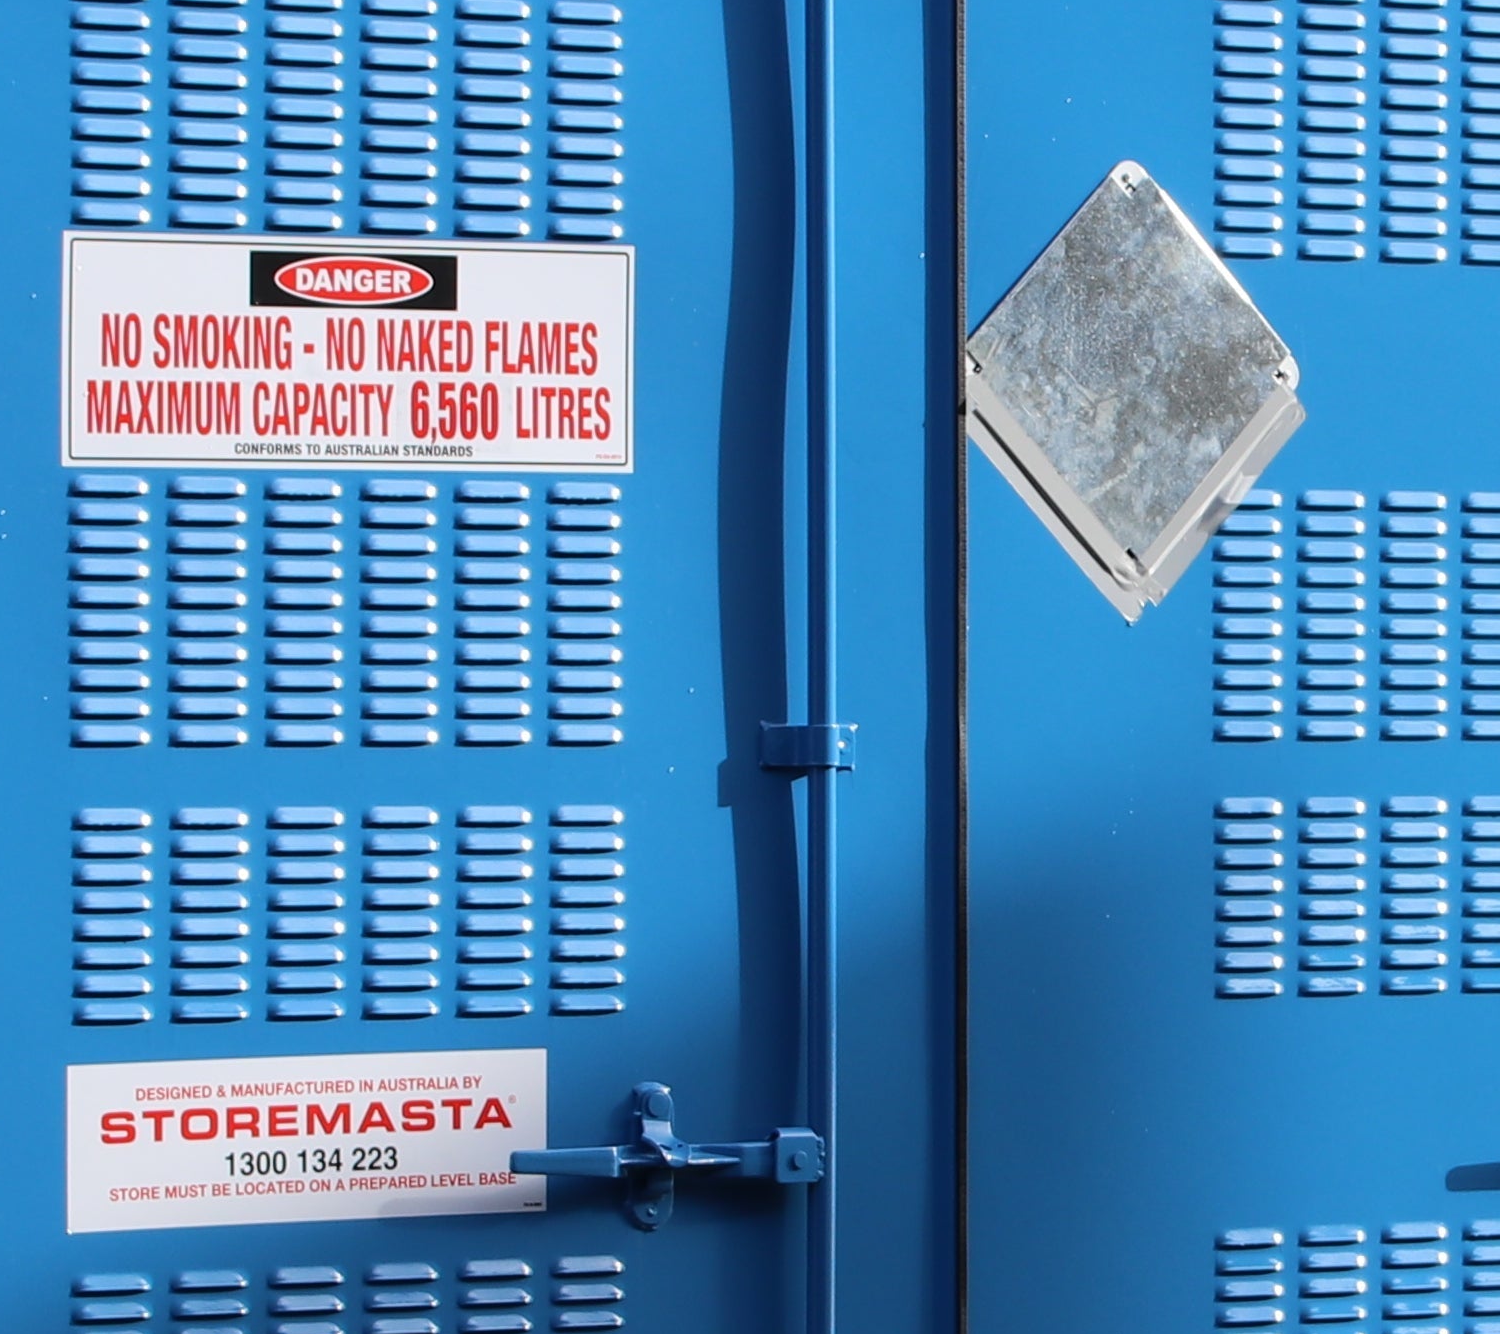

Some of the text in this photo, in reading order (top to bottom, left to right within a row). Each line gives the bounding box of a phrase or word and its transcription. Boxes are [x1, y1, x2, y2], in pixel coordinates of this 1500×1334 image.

[295, 267, 412, 294] DANGER
[101, 312, 142, 369] NO
[153, 312, 293, 371] SMOKING
[326, 316, 365, 372] NO
[377, 318, 474, 373] NAKED
[485, 320, 598, 376] FLAMES
[86, 379, 611, 444] MAXIMUM CAPACITY 6,560 LITRES
[234, 442, 474, 458] CONFORMS TO AUSTRALIAN STANDARDS
[135, 1075, 482, 1102] DESIGNED & MANUFACTURED IN AUSTRALIA BY
[225, 1146, 399, 1177] 1300 134 223
[109, 1170, 517, 1203] STORE MUST BE LOCATED ON A PREPARED LEVEL BASE
